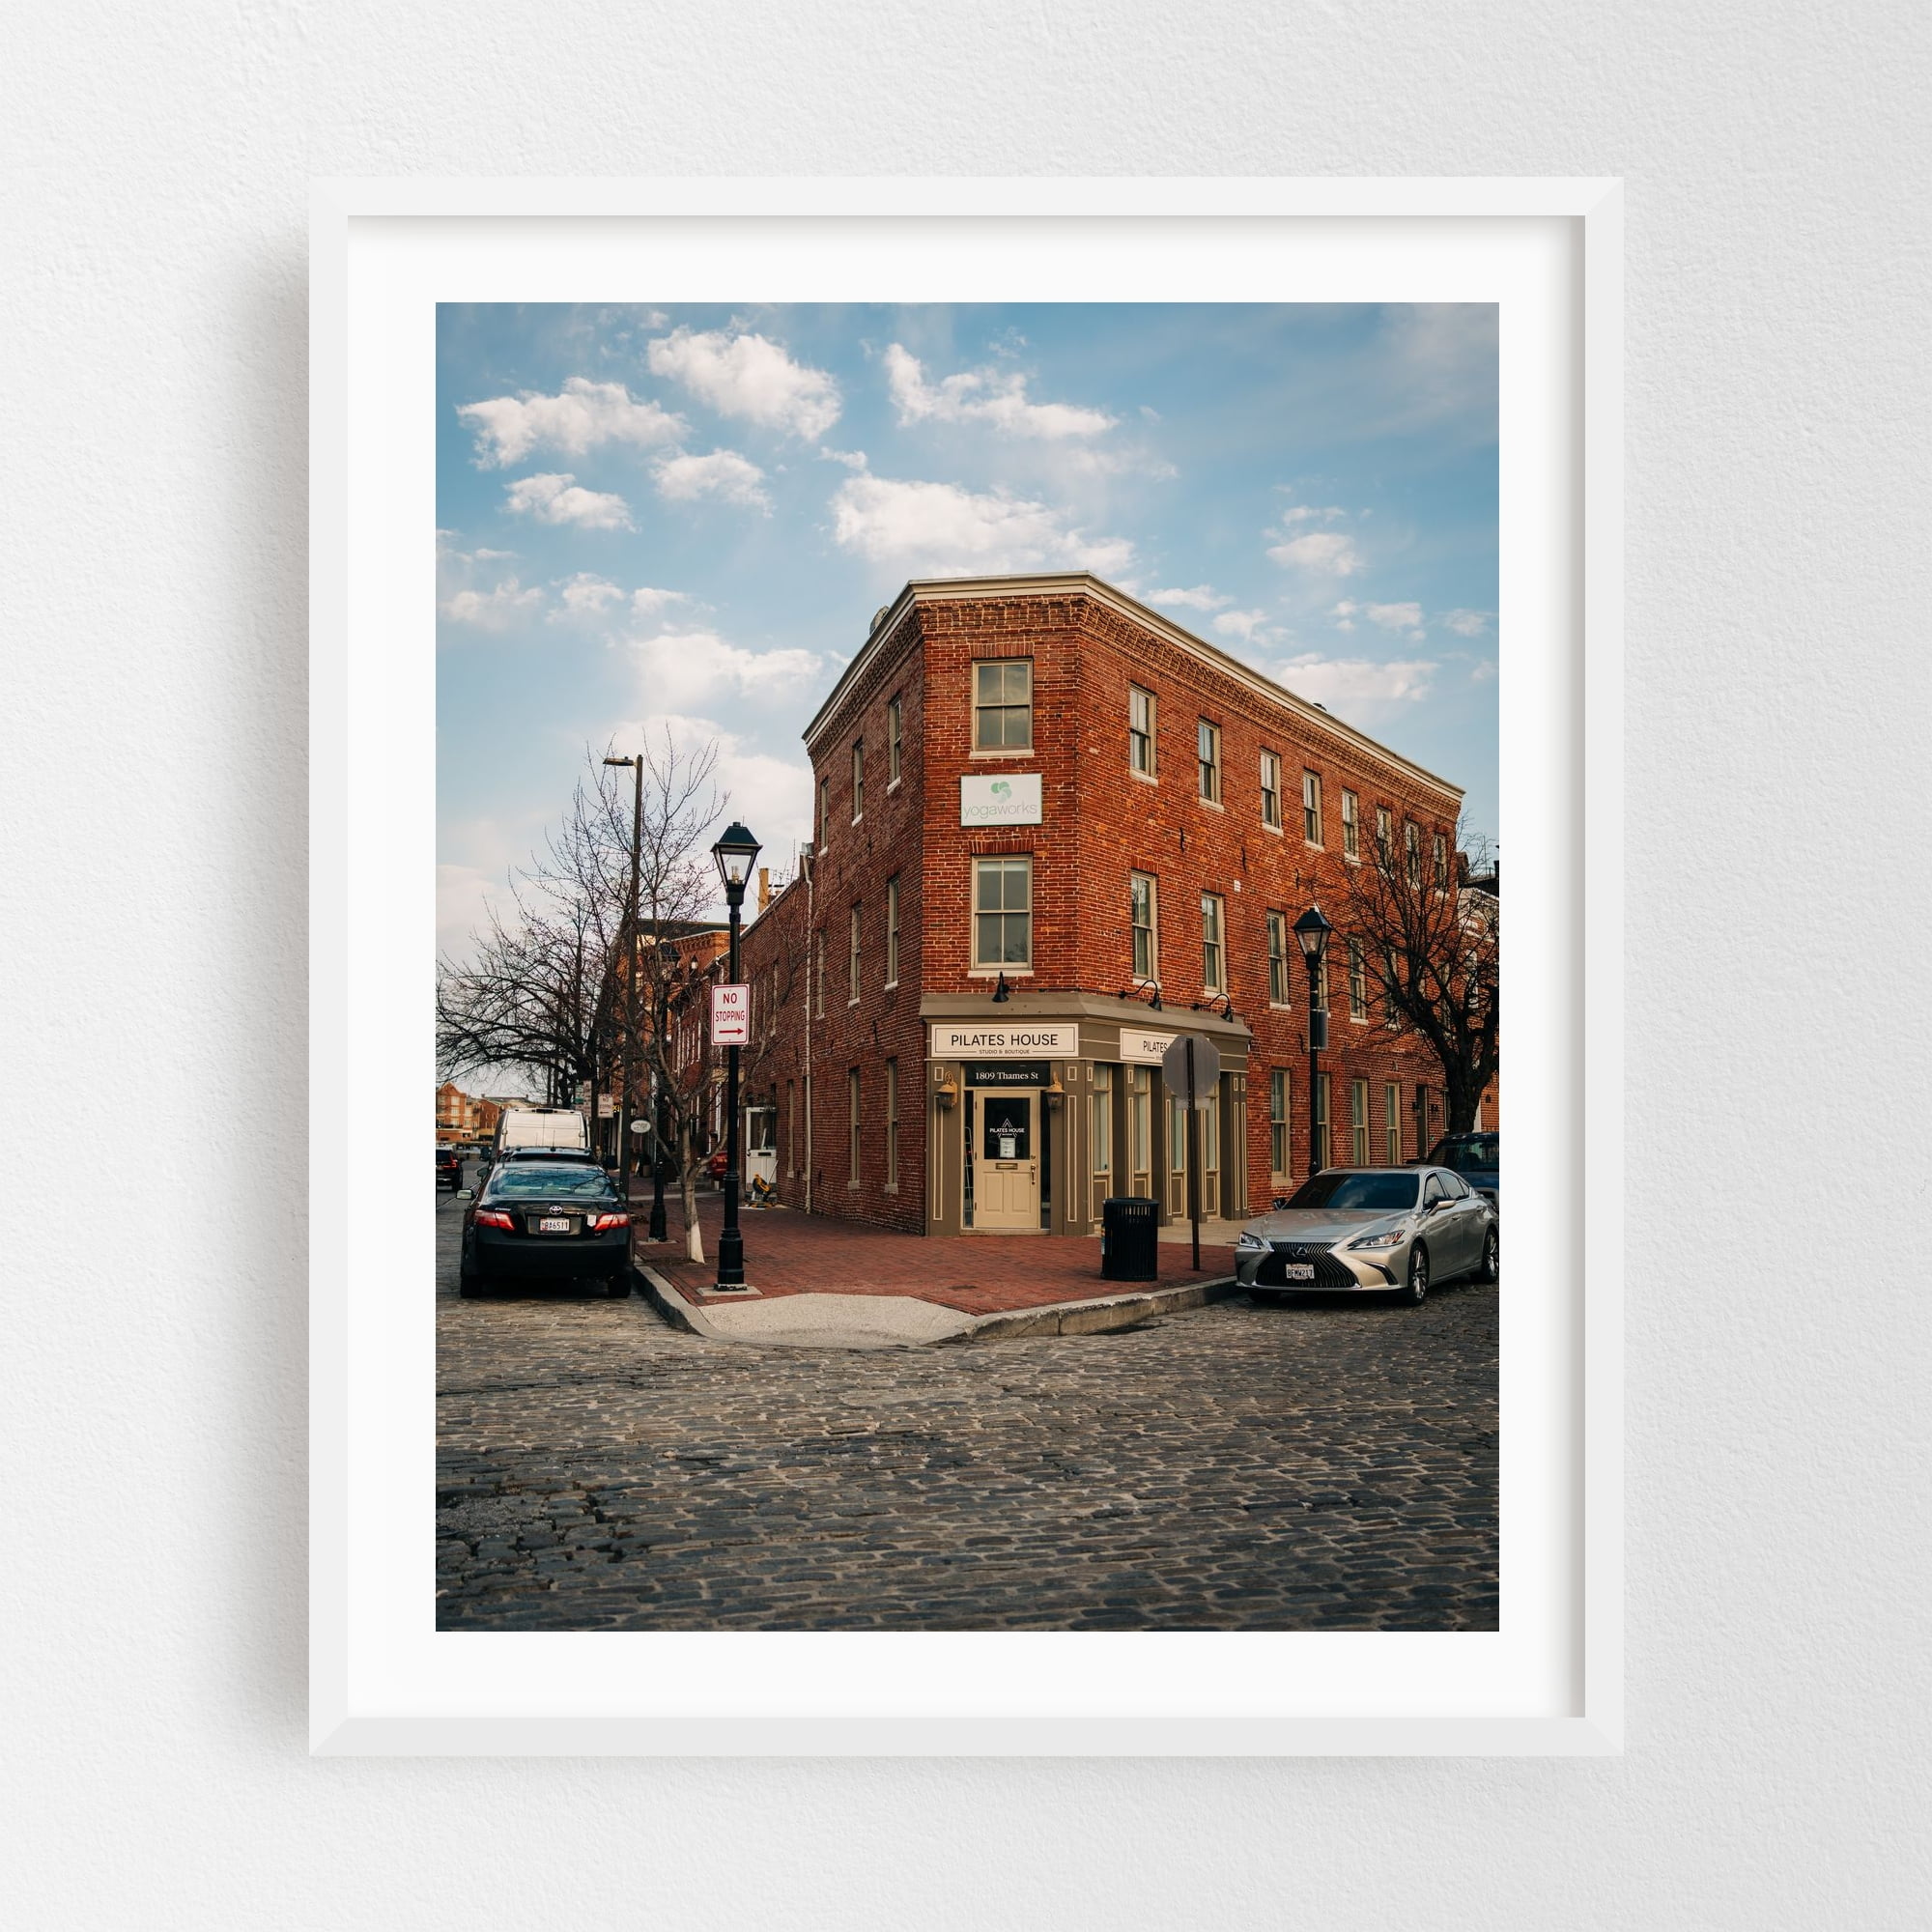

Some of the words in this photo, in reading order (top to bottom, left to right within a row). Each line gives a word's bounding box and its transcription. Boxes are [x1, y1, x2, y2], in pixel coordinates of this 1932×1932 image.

[963, 800, 1037, 819] yogaworks
[723, 992, 737, 1004] NO
[715, 1010, 745, 1021] STOPPING
[951, 1035, 1005, 1045] PILATES
[1010, 1034, 1059, 1045] HOUSE
[1143, 1040, 1168, 1053] PILATES
[998, 1071, 1029, 1080] Thames
[1030, 1071, 1038, 1080] St
